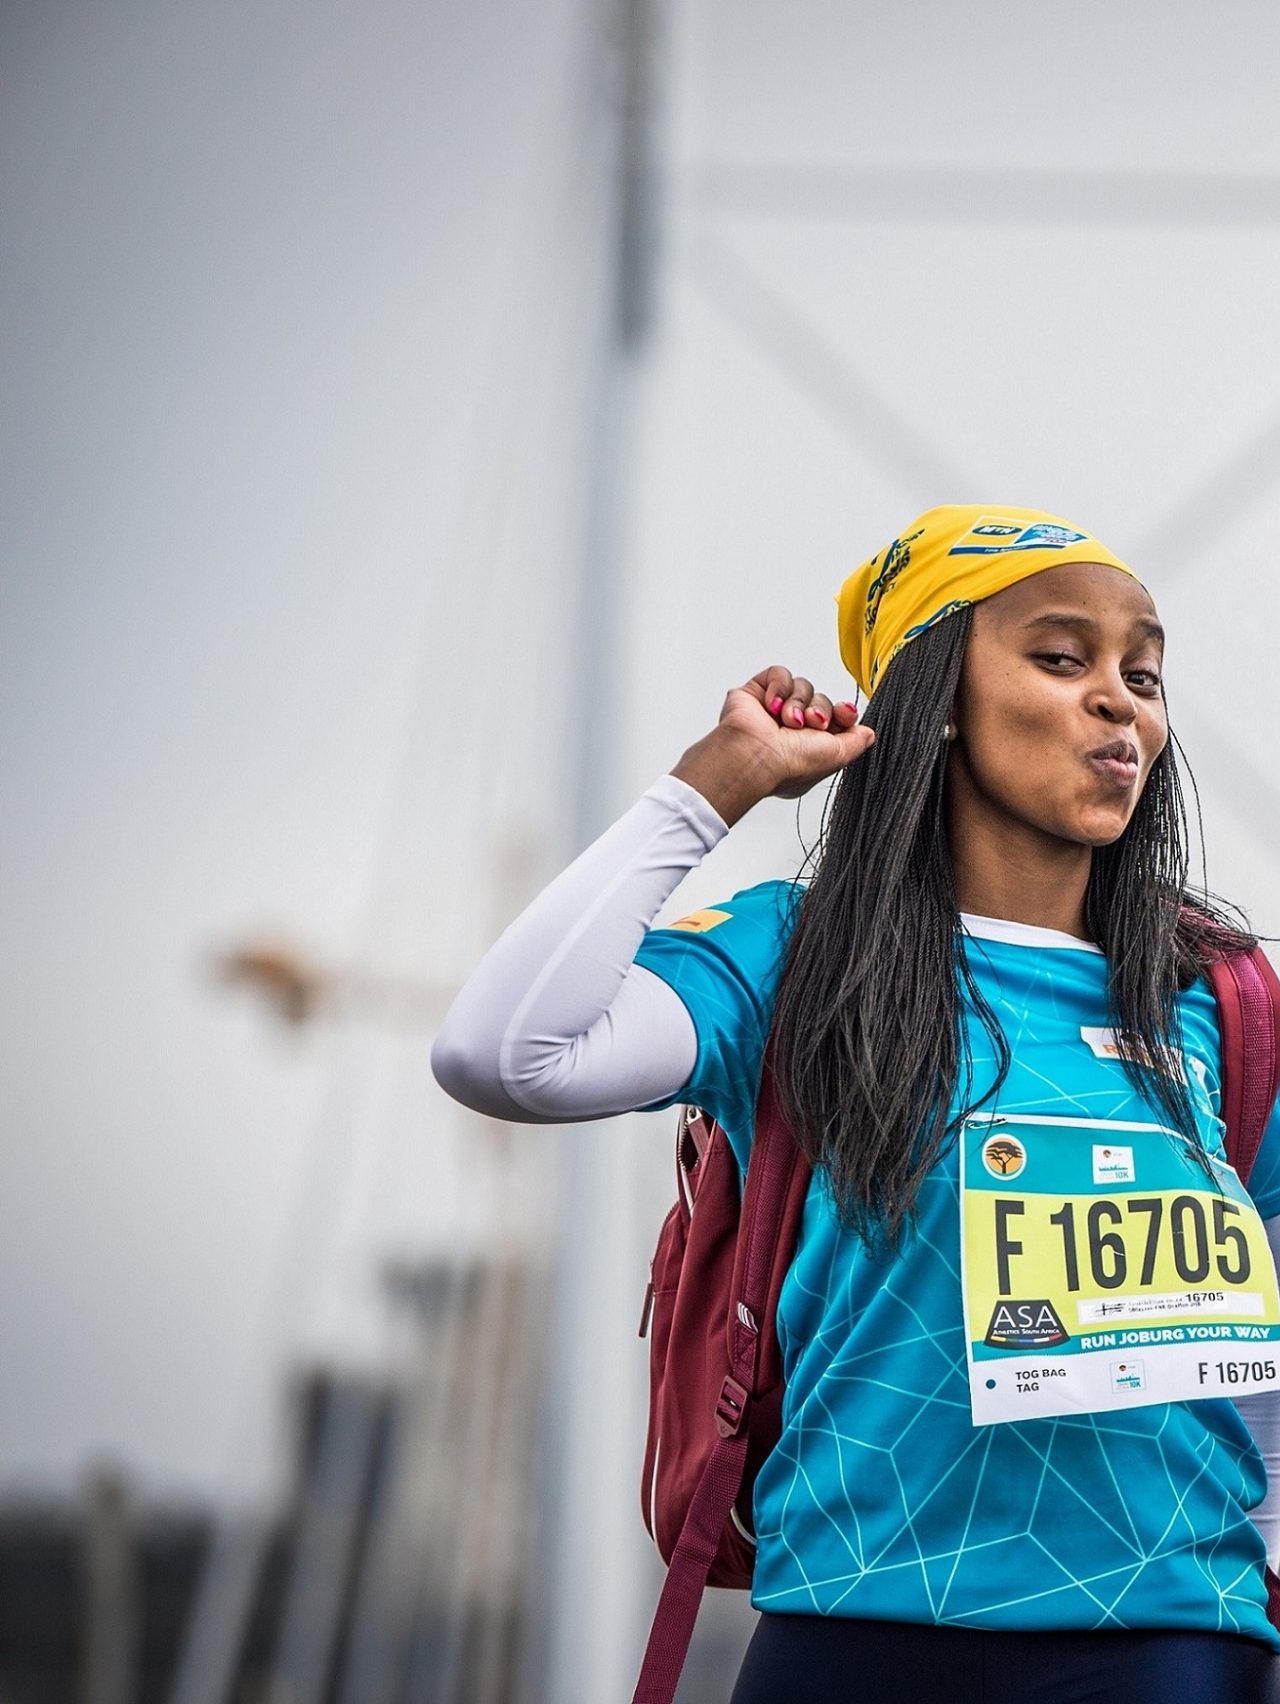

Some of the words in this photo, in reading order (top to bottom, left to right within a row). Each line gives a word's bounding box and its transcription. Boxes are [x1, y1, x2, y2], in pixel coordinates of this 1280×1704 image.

[979, 526, 1015, 534] MTN
[1114, 1171, 1129, 1179] 10K
[994, 1199, 1025, 1296] F
[1050, 1195, 1251, 1292] 16705
[1185, 1292, 1224, 1303] 16705
[993, 1305, 1058, 1329] ASA
[1080, 1334, 1116, 1350] RUN
[1119, 1329, 1185, 1346] JOBURG
[1187, 1325, 1232, 1340] YOUR
[1233, 1326, 1270, 1339] WAY
[1015, 1370, 1039, 1380] TOG
[1042, 1368, 1067, 1378] BAG
[1198, 1362, 1208, 1385] F
[1215, 1360, 1277, 1384] 16705
[1016, 1382, 1040, 1393] TAG
